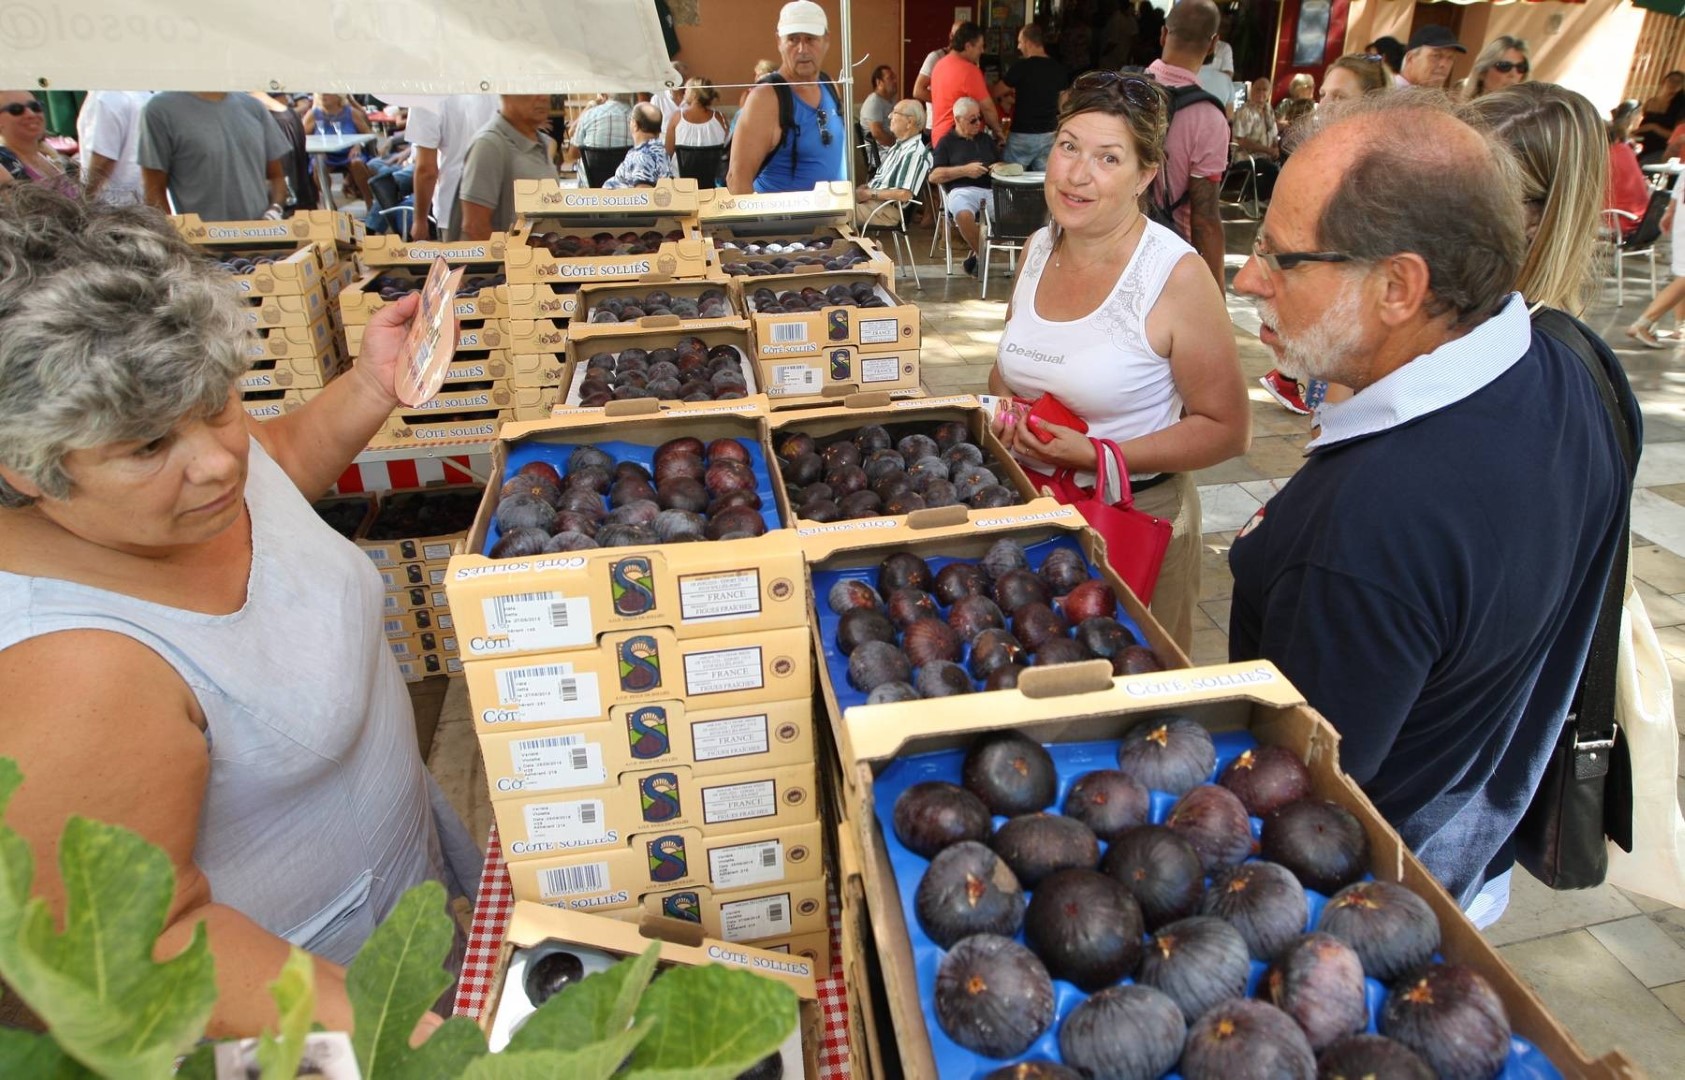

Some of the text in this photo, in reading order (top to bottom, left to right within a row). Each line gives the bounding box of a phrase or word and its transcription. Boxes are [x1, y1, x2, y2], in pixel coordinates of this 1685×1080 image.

[707, 590, 746, 601] FRANCE
[711, 667, 749, 679] FRANCE
[483, 709, 520, 724] CÔT
